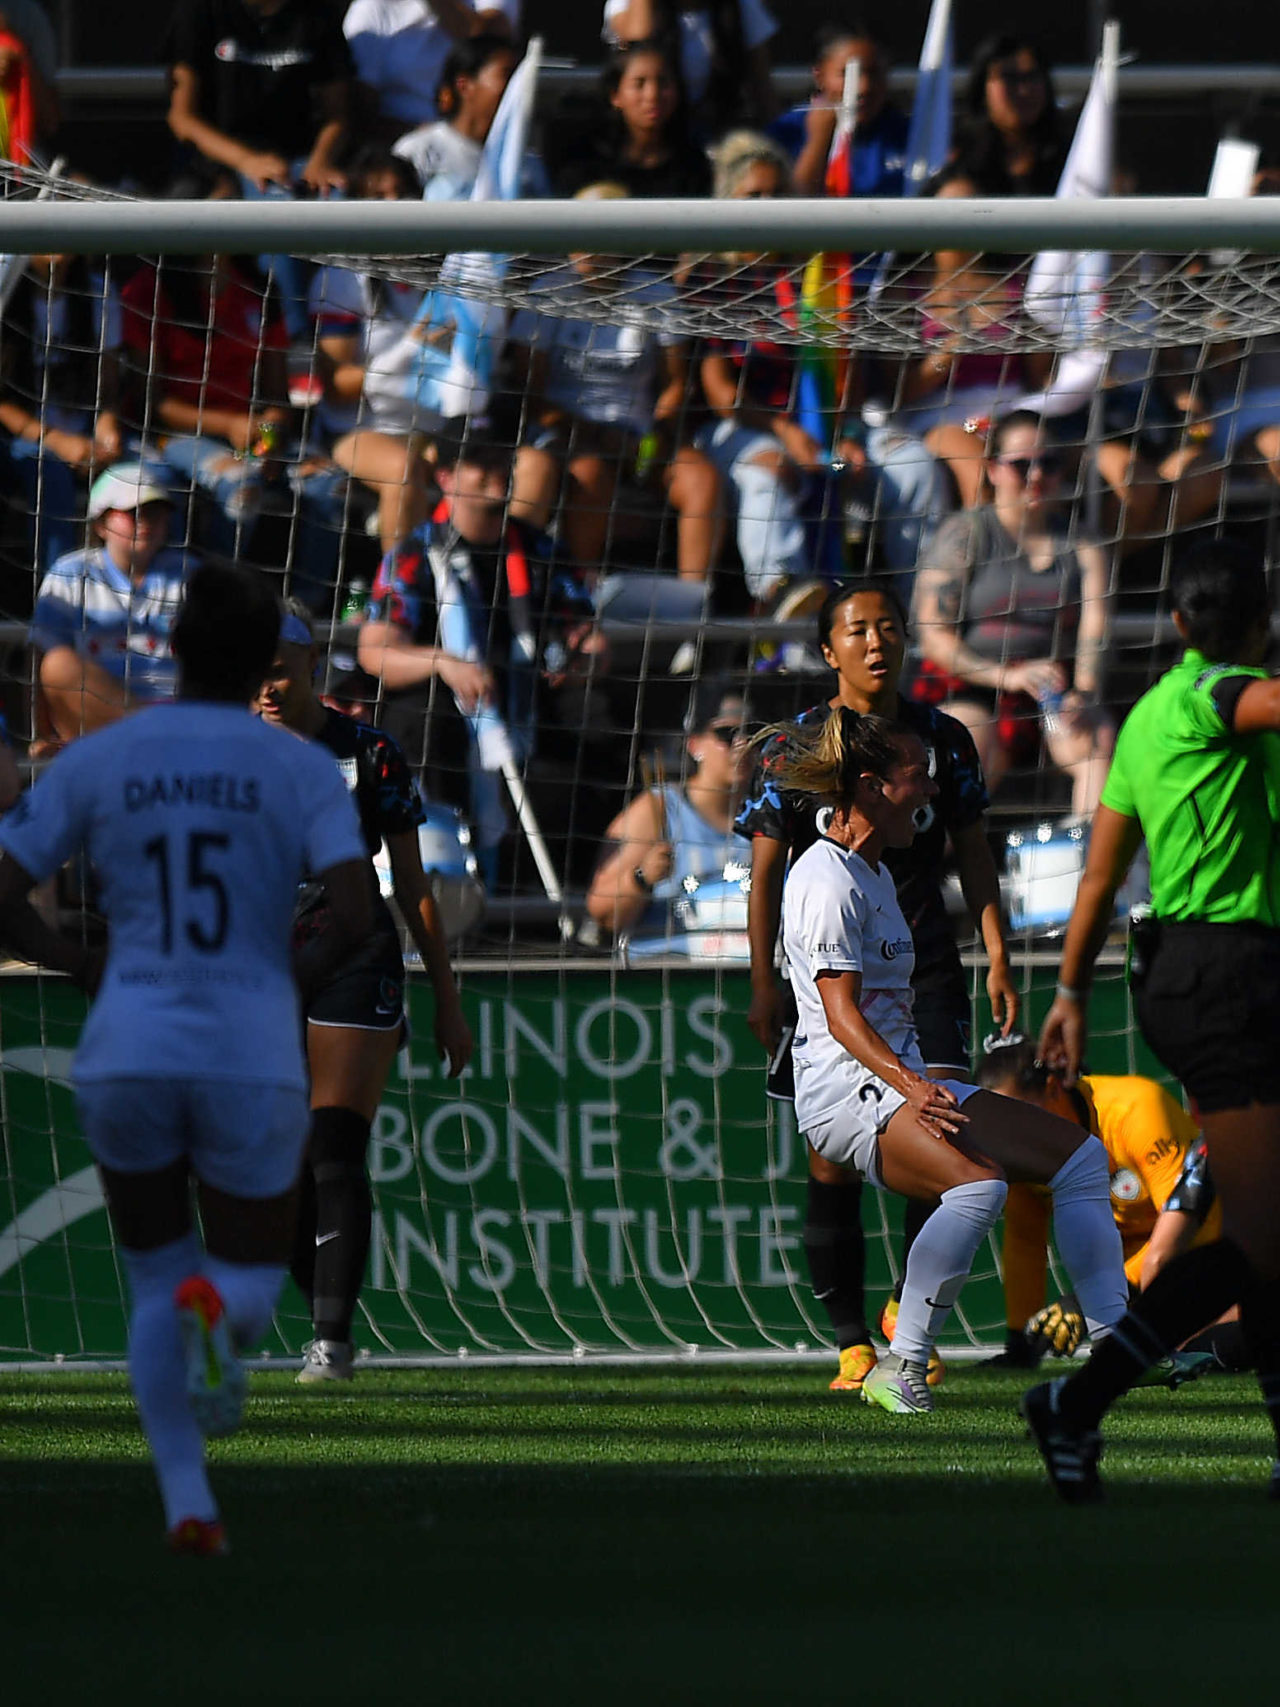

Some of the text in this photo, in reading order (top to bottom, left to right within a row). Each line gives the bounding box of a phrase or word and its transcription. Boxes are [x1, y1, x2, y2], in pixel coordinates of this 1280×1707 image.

[124, 772, 260, 814] DANIELS
[145, 830, 231, 957] 15
[371, 1100, 620, 1184] BONE
[658, 1099, 724, 1181] &
[1145, 1138, 1181, 1166] ally
[371, 1206, 801, 1292] INSTITUTE
